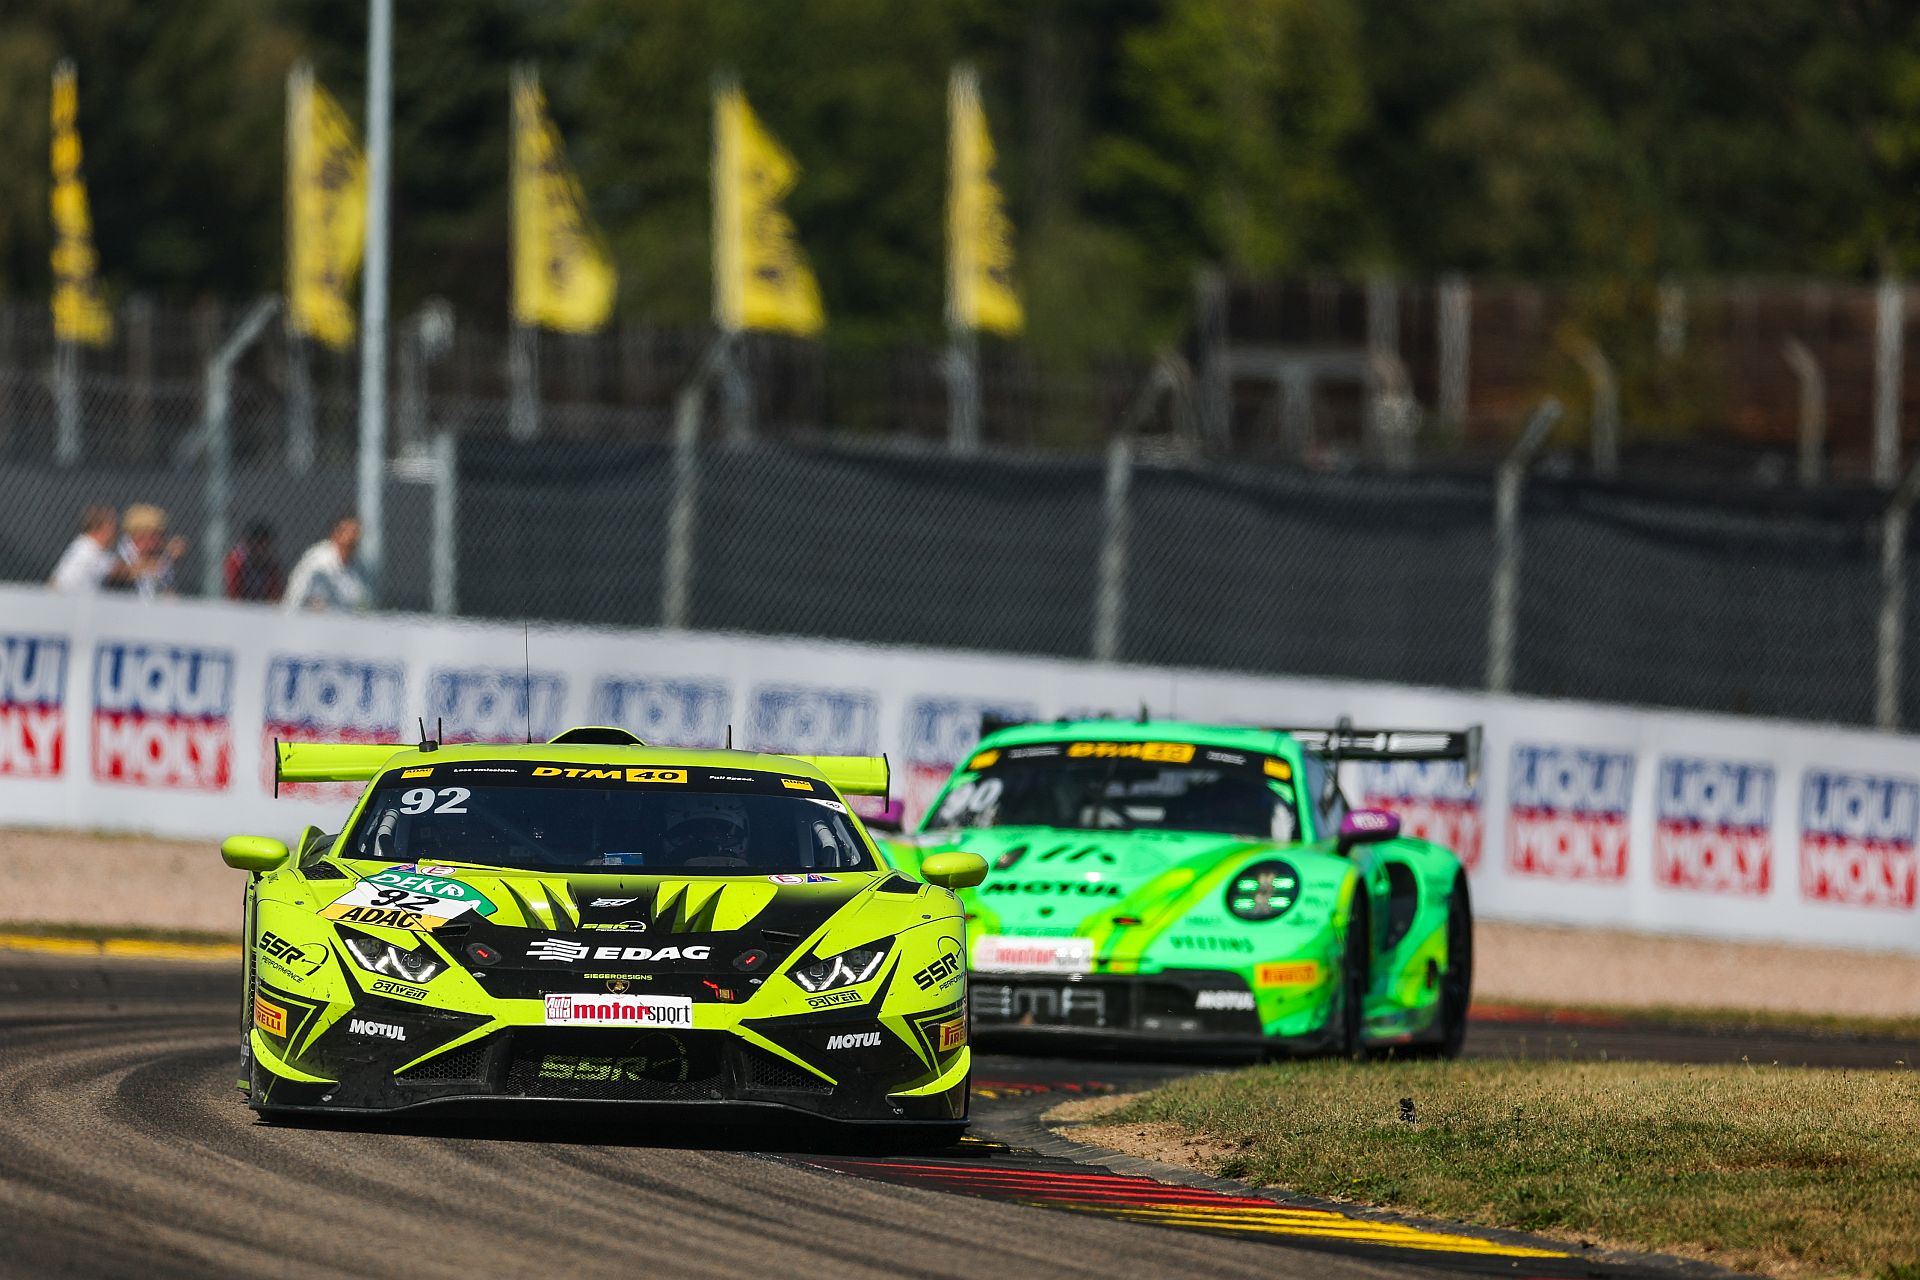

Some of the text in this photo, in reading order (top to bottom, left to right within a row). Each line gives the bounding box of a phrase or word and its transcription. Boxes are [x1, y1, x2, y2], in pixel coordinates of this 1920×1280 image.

[531, 767, 680, 780] DTM 40
[400, 787, 471, 815] 92
[371, 889, 440, 912] 92
[984, 881, 1125, 899] MOTUL
[339, 907, 423, 929] ADAC
[258, 930, 306, 965] SSR
[593, 945, 711, 961] EDAG
[261, 955, 305, 984] PERFORMANCE
[583, 973, 653, 981] SIEGERDESIGNS
[912, 951, 960, 992] SSR
[573, 1002, 691, 1024] motorsport
[349, 1018, 406, 1041] MOTUL
[826, 1031, 882, 1050] MOTUL
[538, 1054, 649, 1082] SSR
